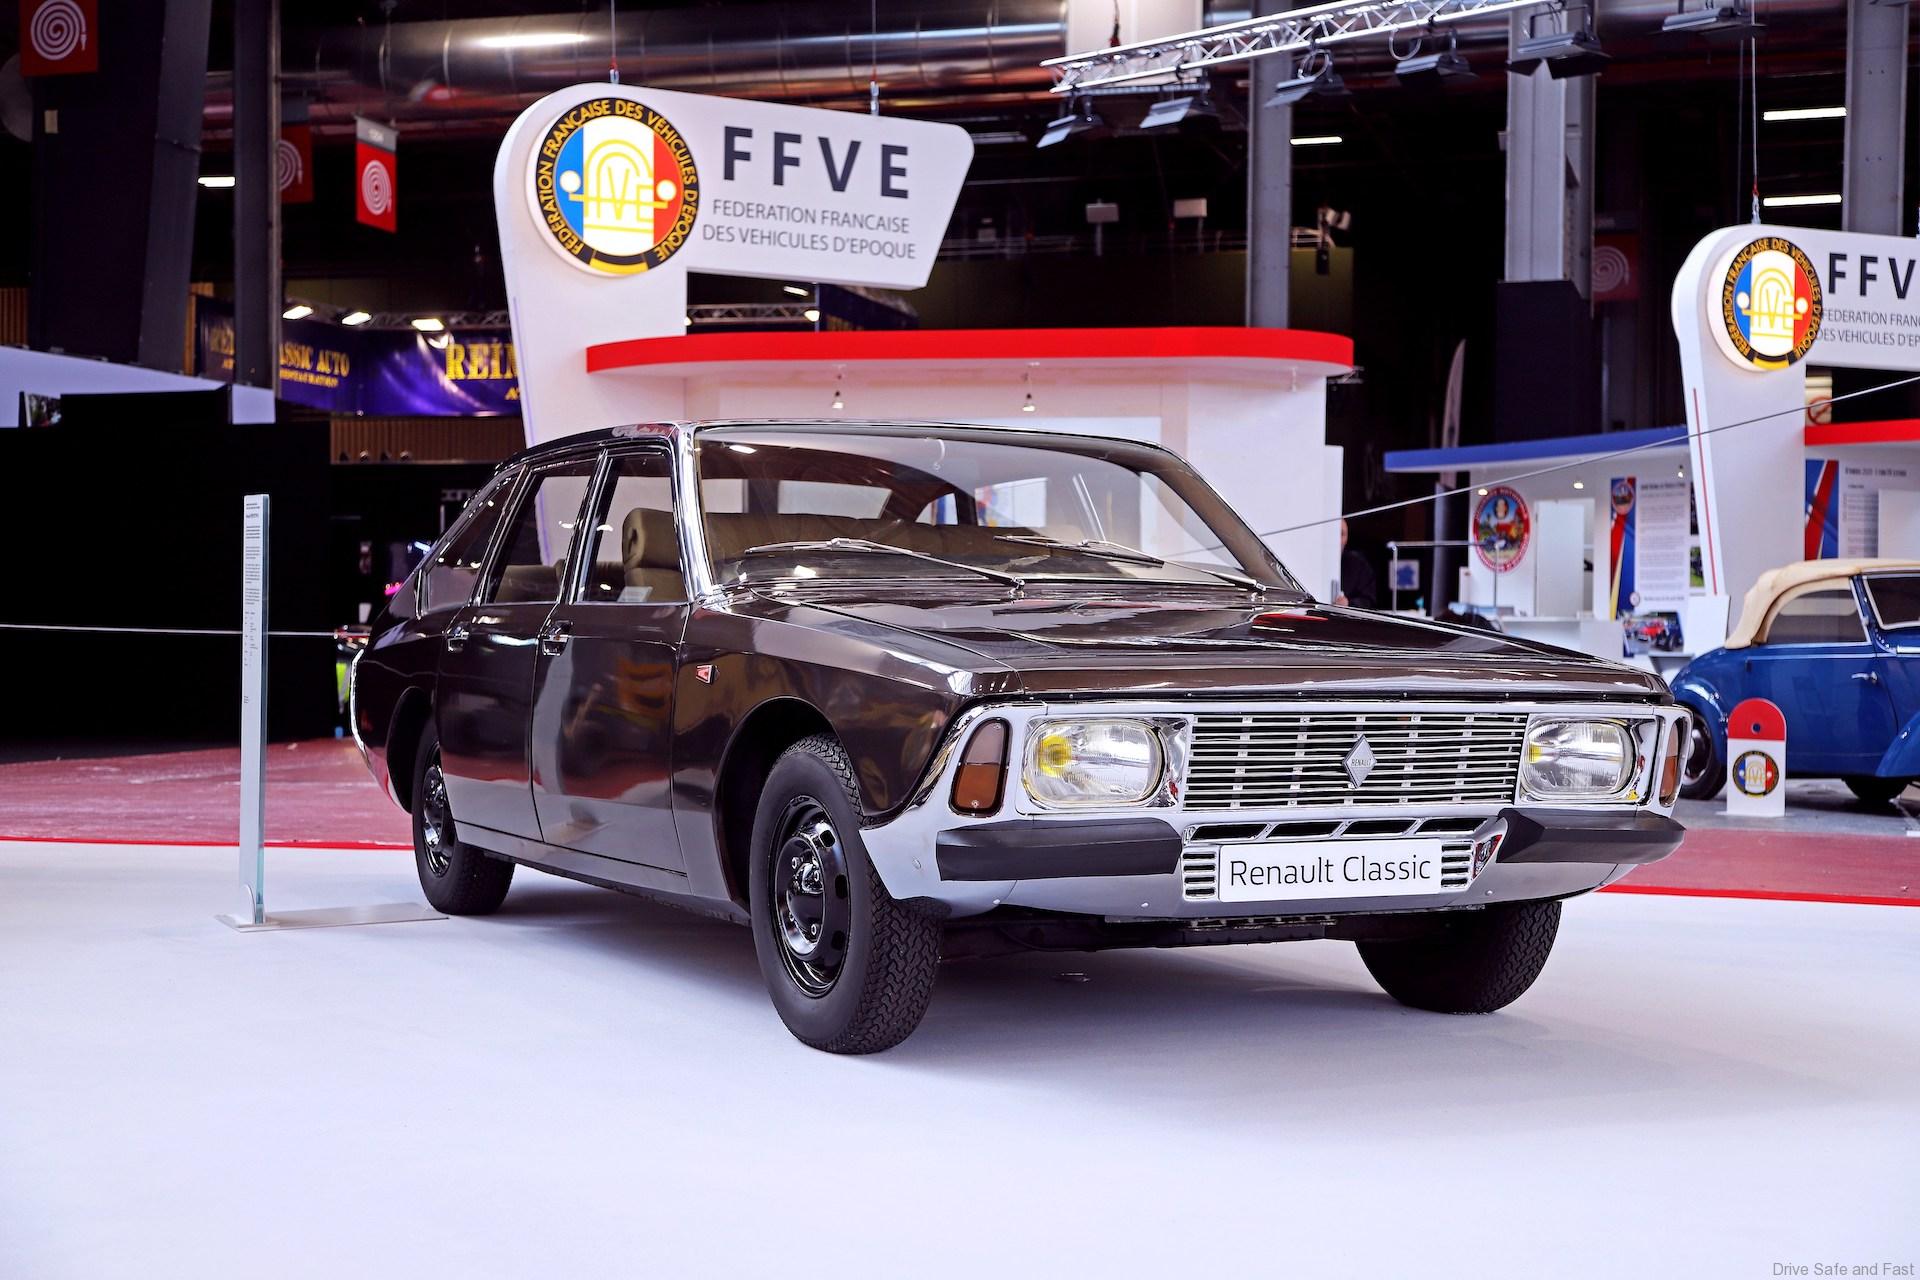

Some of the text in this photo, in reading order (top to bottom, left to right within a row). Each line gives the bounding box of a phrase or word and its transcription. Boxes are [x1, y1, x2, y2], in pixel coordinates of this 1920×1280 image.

[615, 100, 644, 120] DES
[724, 125, 909, 199] FFVE
[713, 199, 909, 233] FEDERATION FRANCAISE
[702, 224, 916, 259] DES VEHICULES D'EPOQUE
[1771, 239, 1791, 252] DES
[1890, 312, 1920, 327] FRAN
[1838, 330, 1895, 345] VEHICULES
[316, 350, 349, 377] AUTO
[1230, 854, 1431, 886] Renault Classic
